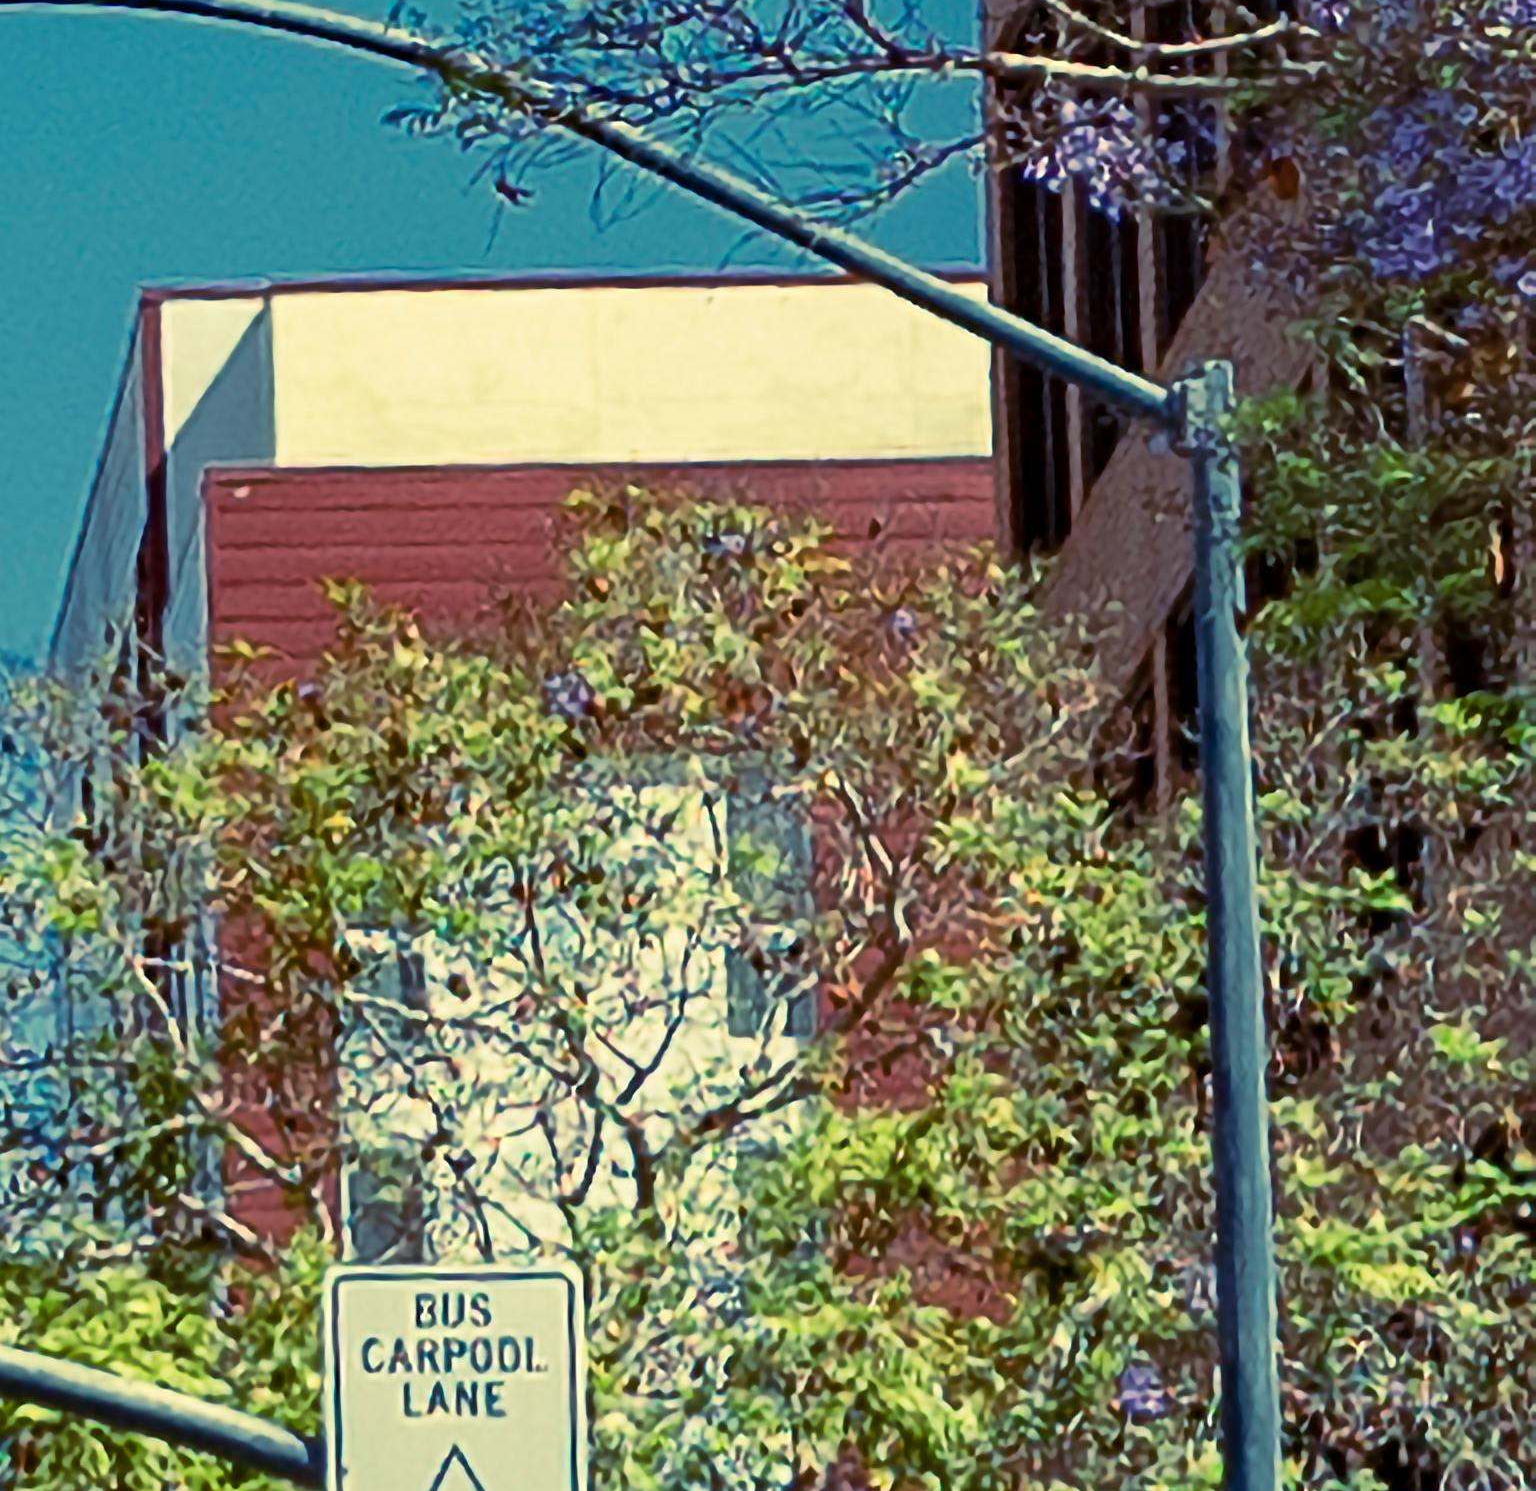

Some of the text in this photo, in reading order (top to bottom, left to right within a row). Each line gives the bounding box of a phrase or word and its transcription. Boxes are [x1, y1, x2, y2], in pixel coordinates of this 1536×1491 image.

[414, 1291, 492, 1330] BUS
[360, 1336, 549, 1374] CARPOOL
[402, 1380, 508, 1418] LANE
